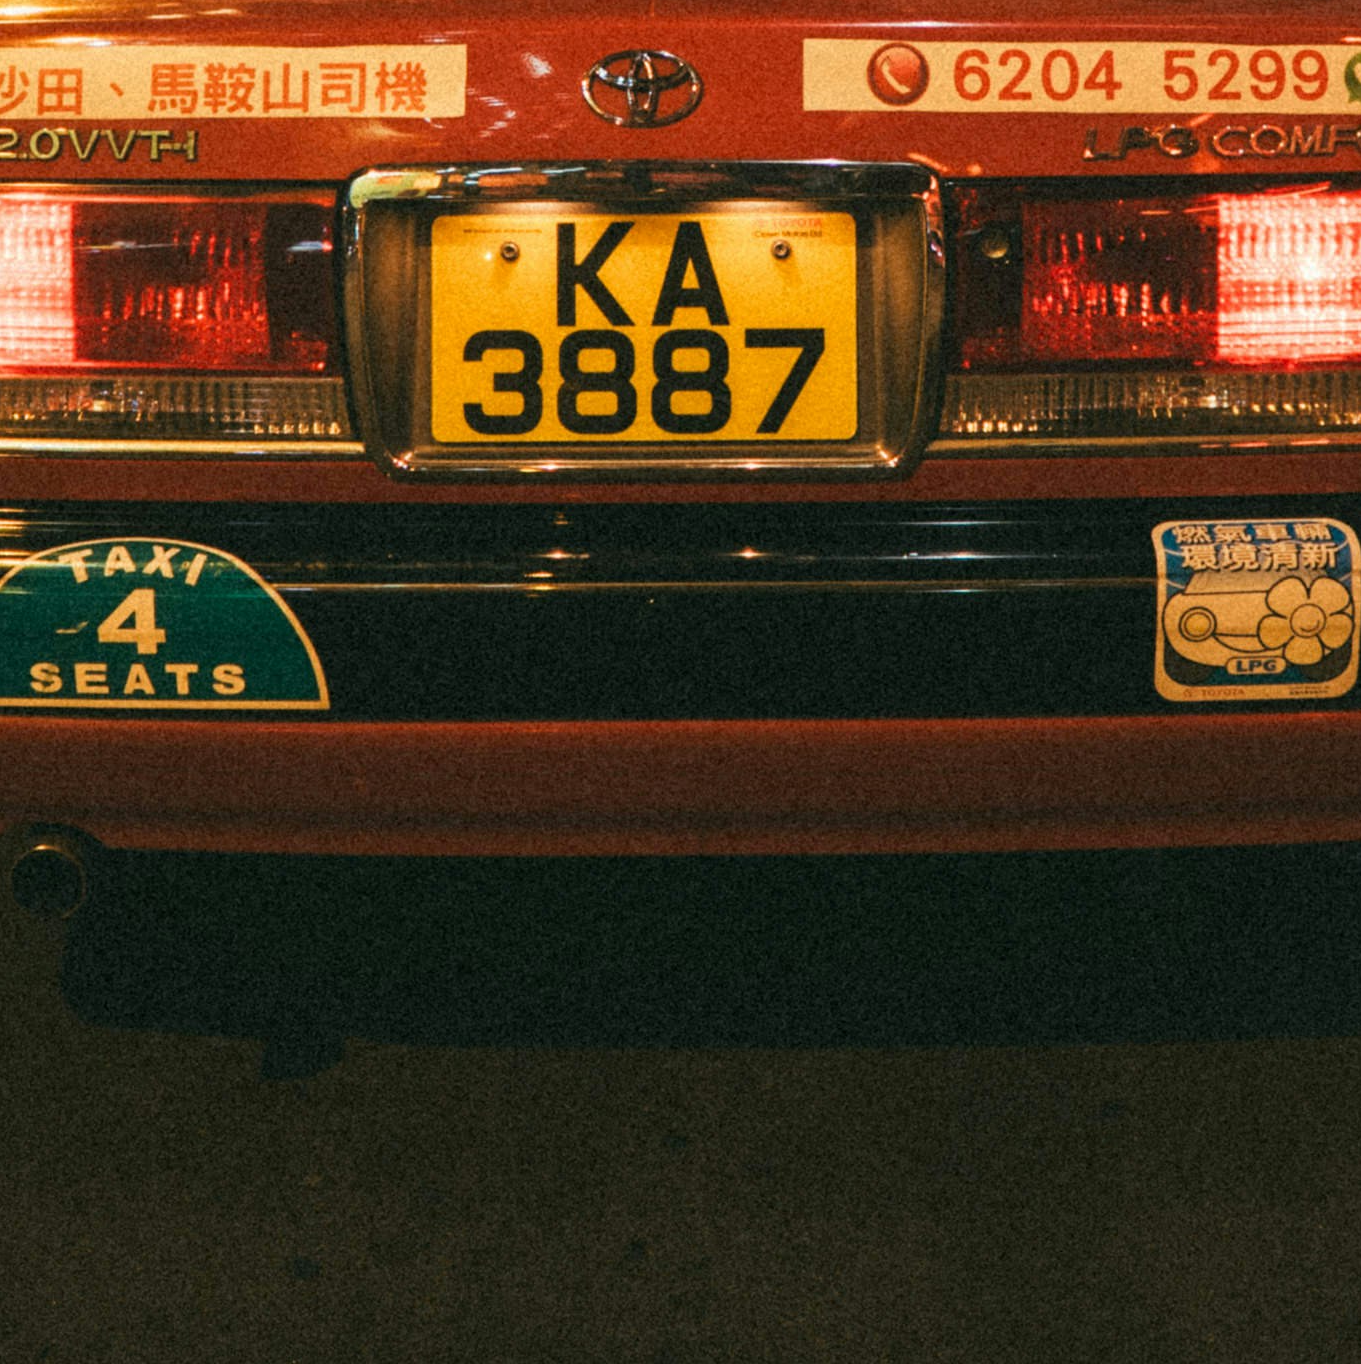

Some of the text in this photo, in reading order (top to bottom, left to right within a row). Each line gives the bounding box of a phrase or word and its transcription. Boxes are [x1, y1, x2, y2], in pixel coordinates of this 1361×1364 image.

[952, 47, 1331, 102] 6204 5299
[1082, 123, 1200, 161] LPG
[556, 221, 730, 326] KA
[463, 328, 825, 435] 3887
[58, 545, 208, 587] TAXI
[1180, 541, 1338, 571] 環境清新
[96, 588, 167, 655] 4
[29, 662, 246, 696] SEATS
[1236, 660, 1277, 673] LPG
